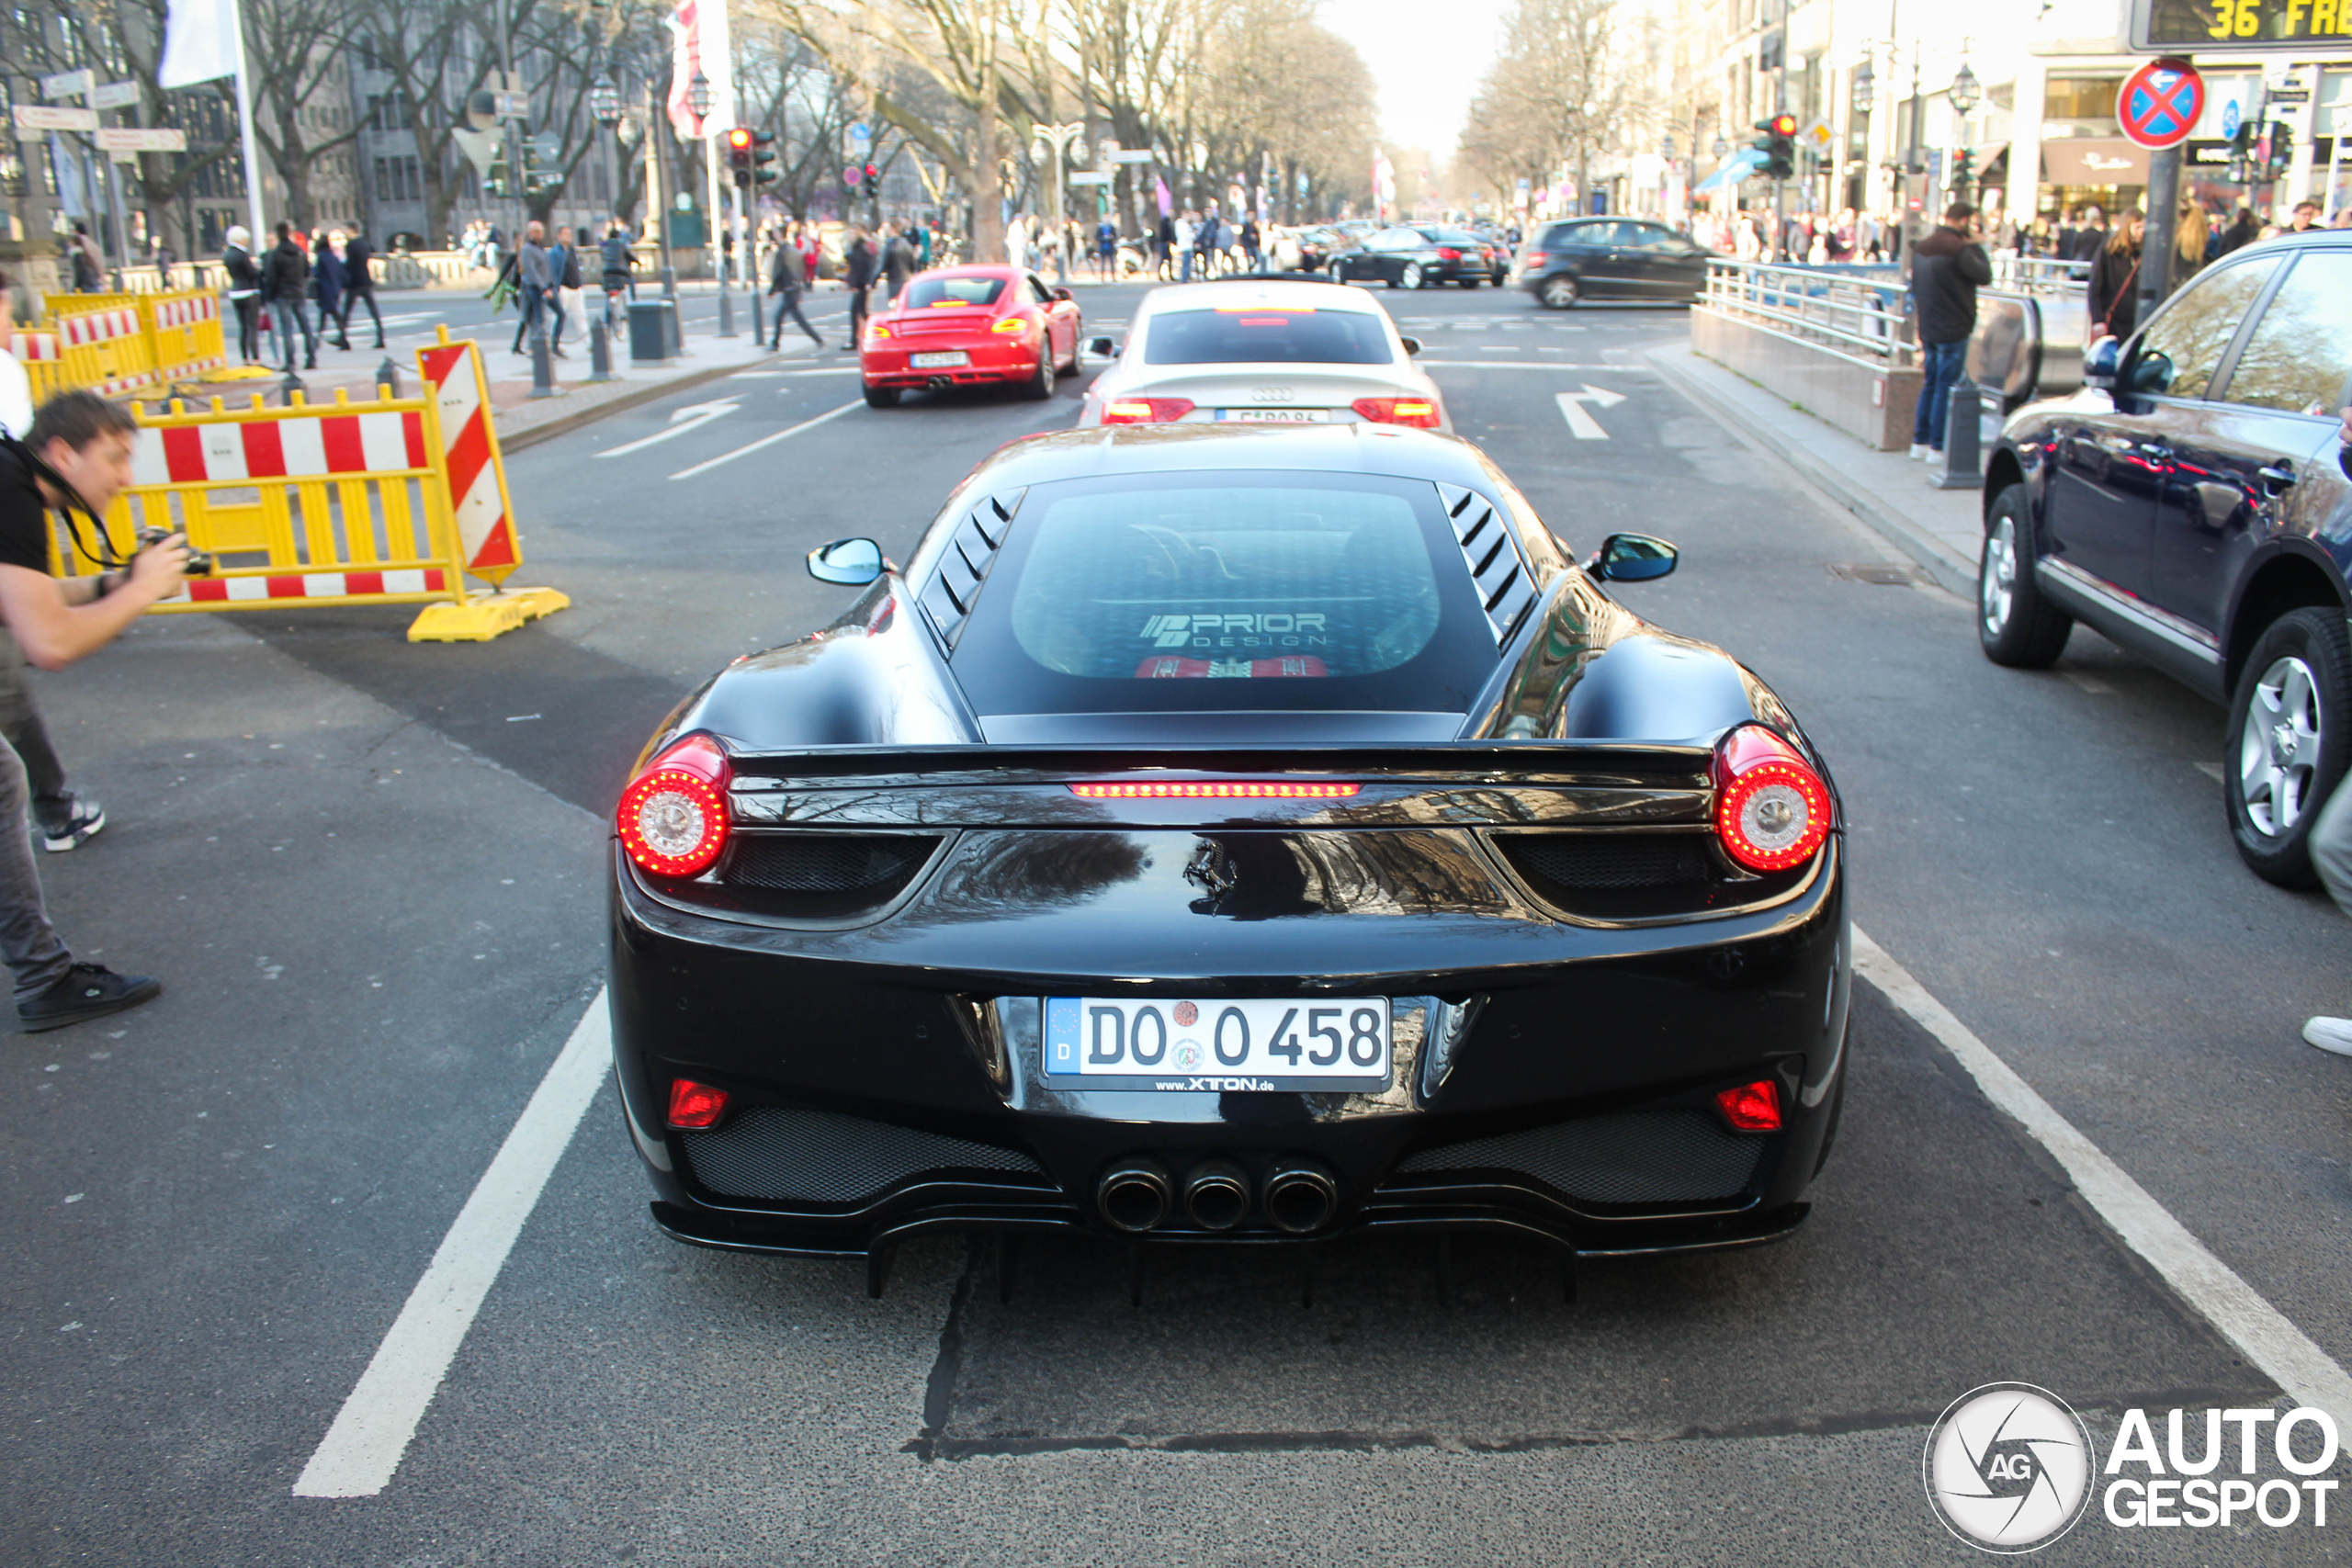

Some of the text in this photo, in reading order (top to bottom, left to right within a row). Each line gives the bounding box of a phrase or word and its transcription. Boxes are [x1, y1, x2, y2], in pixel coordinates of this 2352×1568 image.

[2208, 0, 2261, 38] 36
[1193, 613, 1327, 634] PRIOR
[1193, 635, 1327, 648] DESIGN
[1089, 1006, 1167, 1066] DO
[1214, 1006, 1250, 1066] O
[1268, 1008, 1383, 1066] 458
[1057, 1043, 1070, 1060] D
